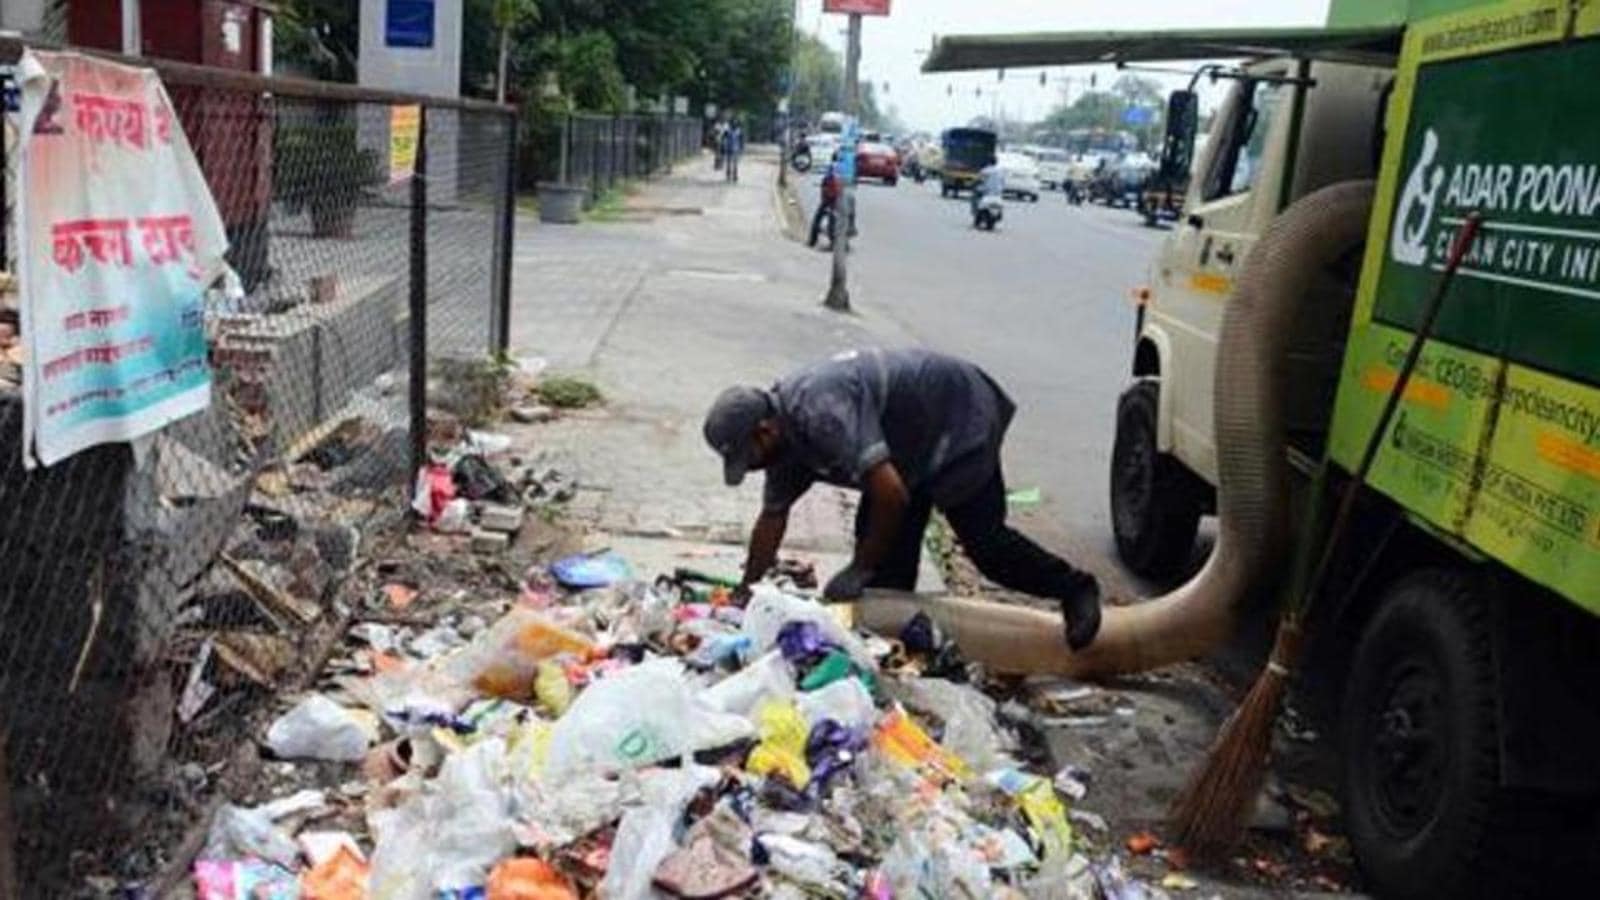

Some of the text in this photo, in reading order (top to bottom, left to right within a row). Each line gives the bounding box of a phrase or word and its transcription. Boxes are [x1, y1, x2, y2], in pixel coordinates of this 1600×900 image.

[1444, 164, 1512, 210] ADAR
[1434, 230, 1499, 266] CLAN
[1502, 239, 1554, 276] CITY
